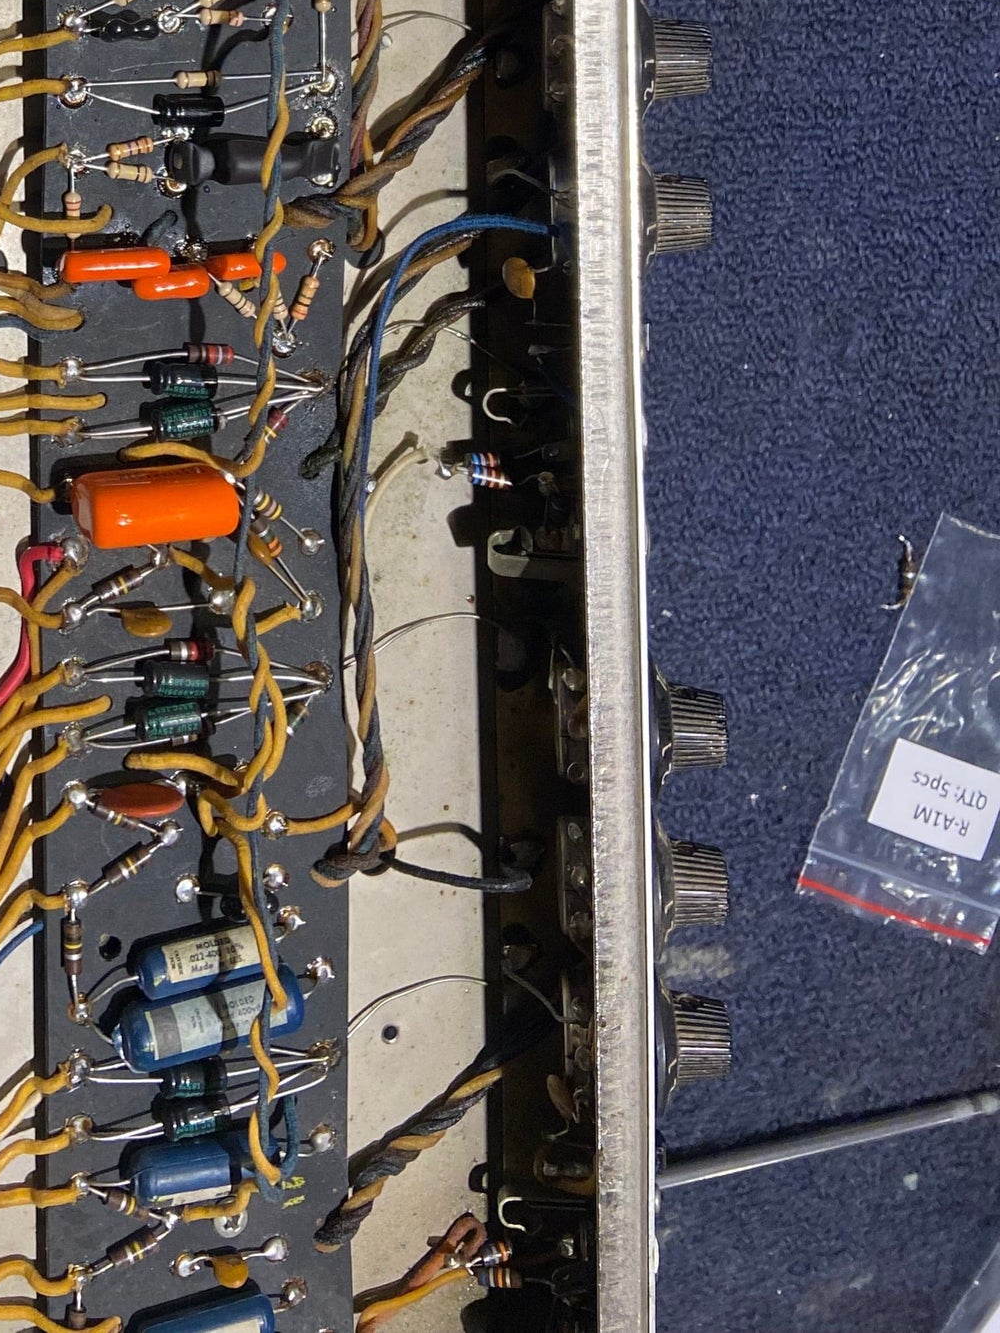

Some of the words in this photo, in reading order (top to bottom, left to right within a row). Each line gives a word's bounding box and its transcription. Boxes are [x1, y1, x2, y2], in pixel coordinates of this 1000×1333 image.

[911, 771, 952, 798] 5pcs
[955, 786, 988, 810] QTY:
[913, 804, 971, 837] R-A1M
[195, 936, 231, 950] MOLDED
[191, 961, 214, 972] Made
